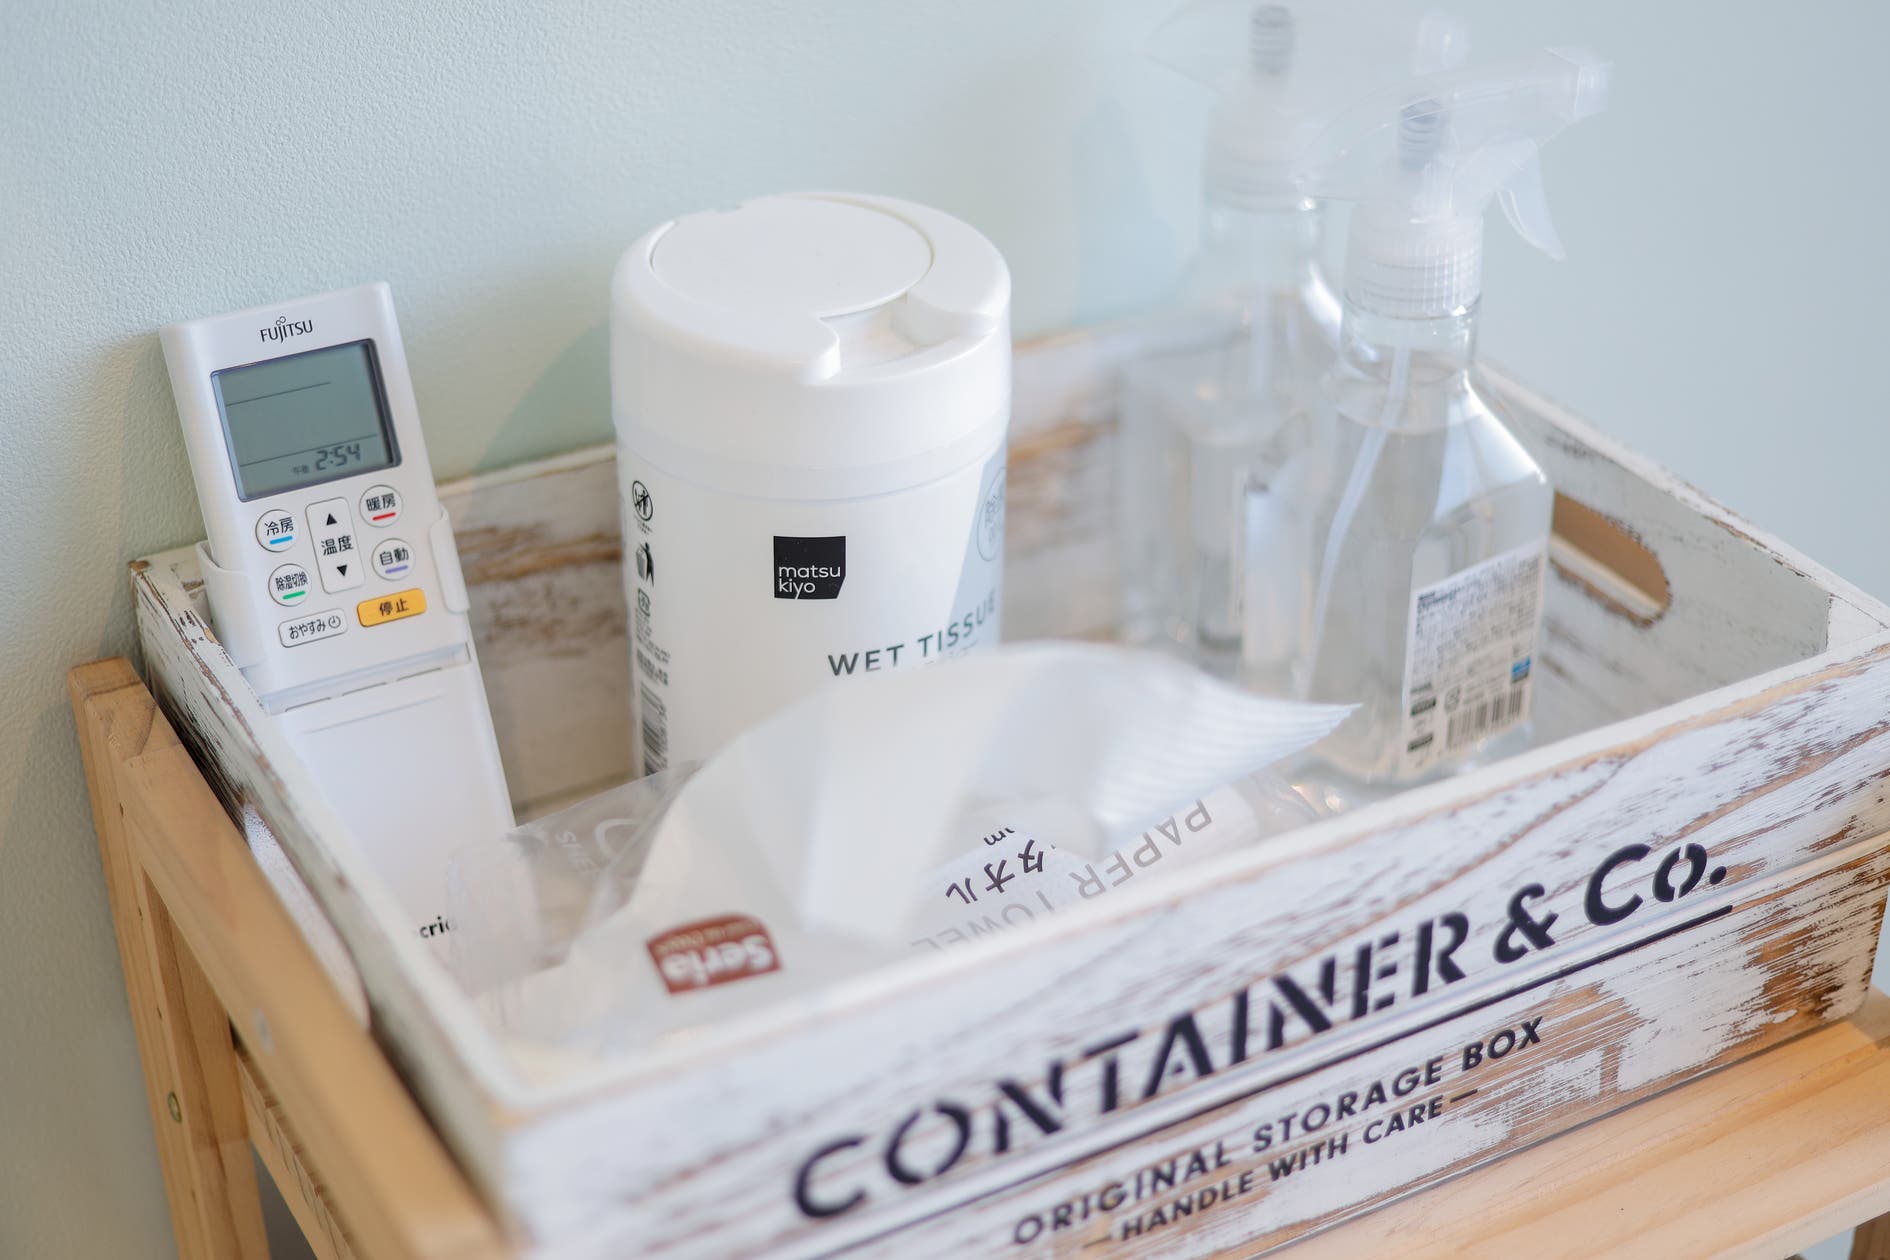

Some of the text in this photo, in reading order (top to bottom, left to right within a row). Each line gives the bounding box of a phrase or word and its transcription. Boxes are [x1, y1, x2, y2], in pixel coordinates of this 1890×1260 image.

[260, 316, 313, 343] FUJITSU
[315, 444, 360, 471] 2:54
[366, 493, 396, 512] 暖房
[265, 516, 294, 536] 冷房
[321, 535, 353, 556] 温度
[379, 547, 409, 566] 自動
[779, 565, 841, 578] matsu
[779, 578, 816, 600] kiyo
[379, 598, 409, 617] 停止
[289, 618, 327, 640] おやすみ
[828, 644, 904, 677] WET
[946, 839, 1055, 905] タオル
[794, 910, 1469, 1219] CONTAINER
[1493, 883, 1559, 963] &
[1584, 843, 1727, 926] Co.
[1013, 1016, 1543, 1244] ORIGINAL STORAGE BOX
[1120, 1095, 1443, 1241] HANDLE WITH CARE
